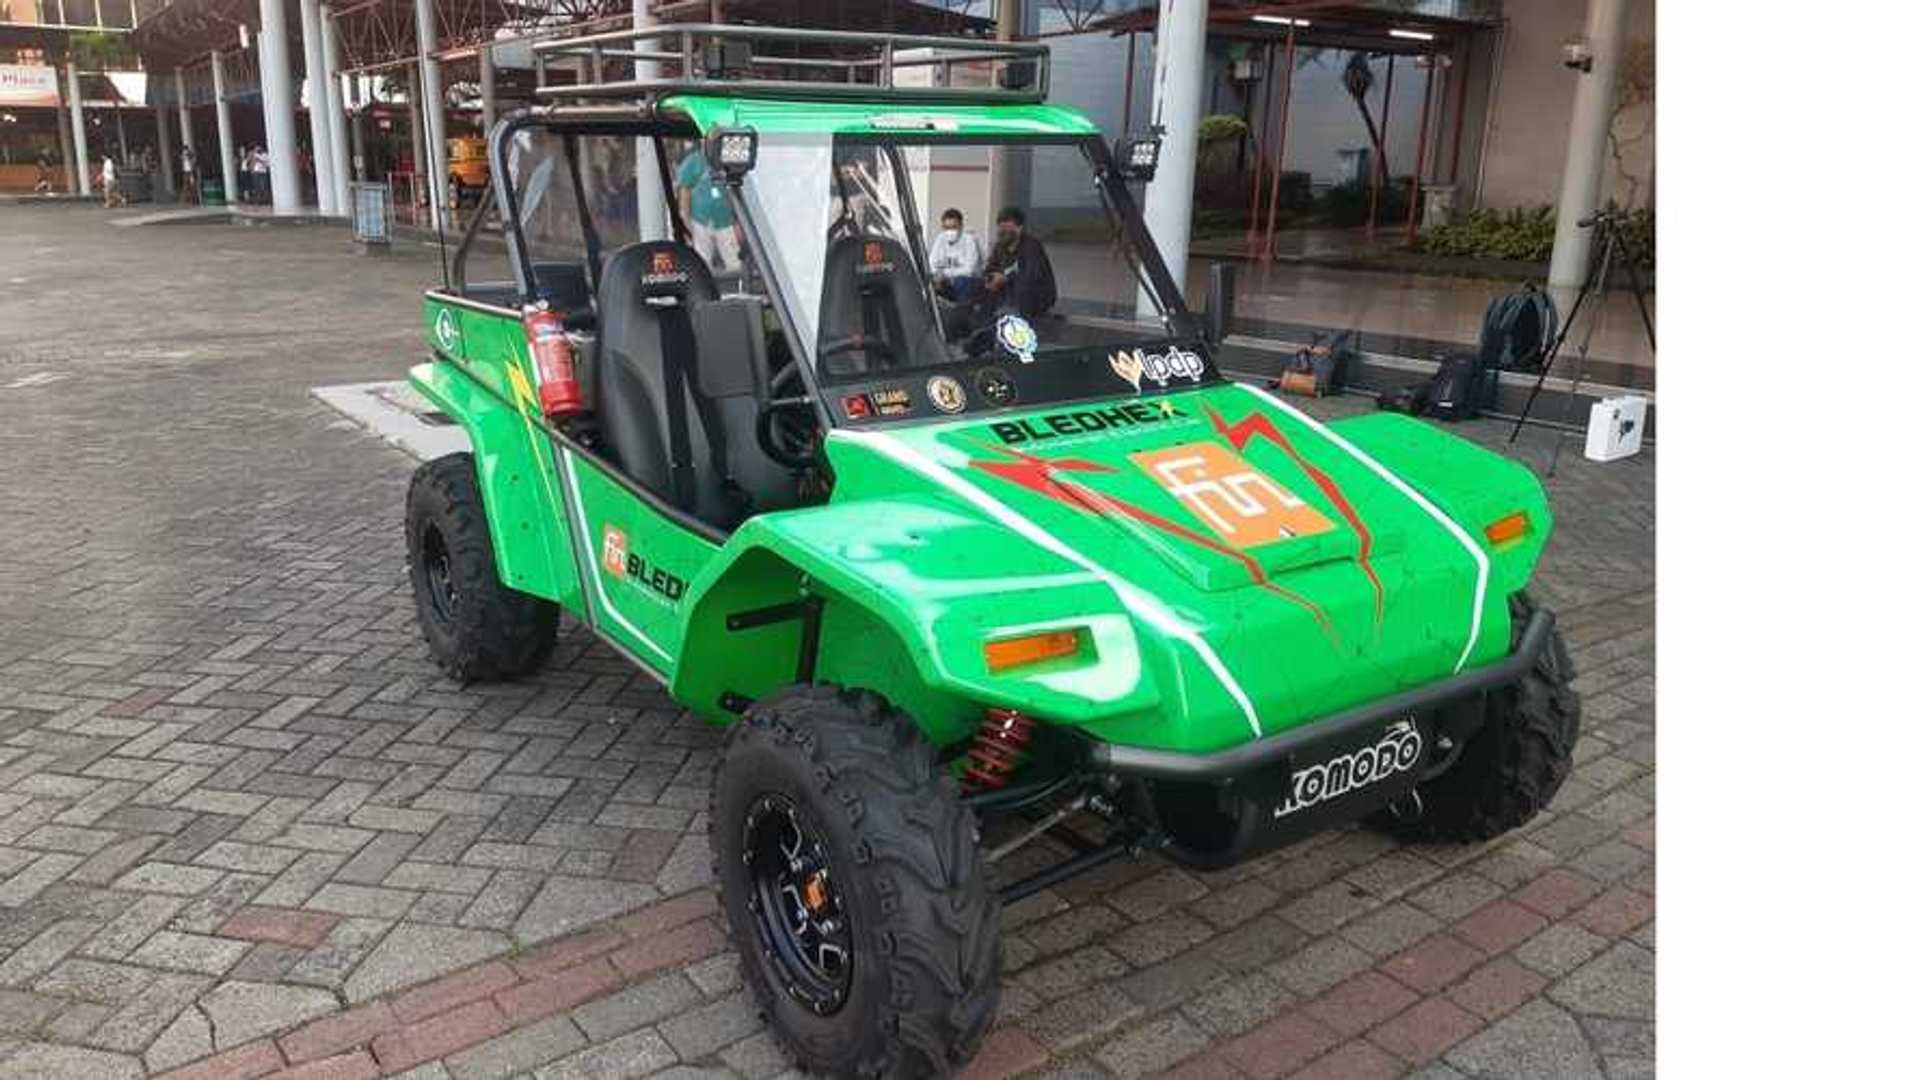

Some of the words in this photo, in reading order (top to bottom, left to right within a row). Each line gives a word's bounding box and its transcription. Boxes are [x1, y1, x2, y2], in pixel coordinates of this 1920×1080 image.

[1136, 345, 1204, 387] lpdp
[989, 401, 1189, 445] BLEDHEX
[627, 552, 690, 602] BLED
